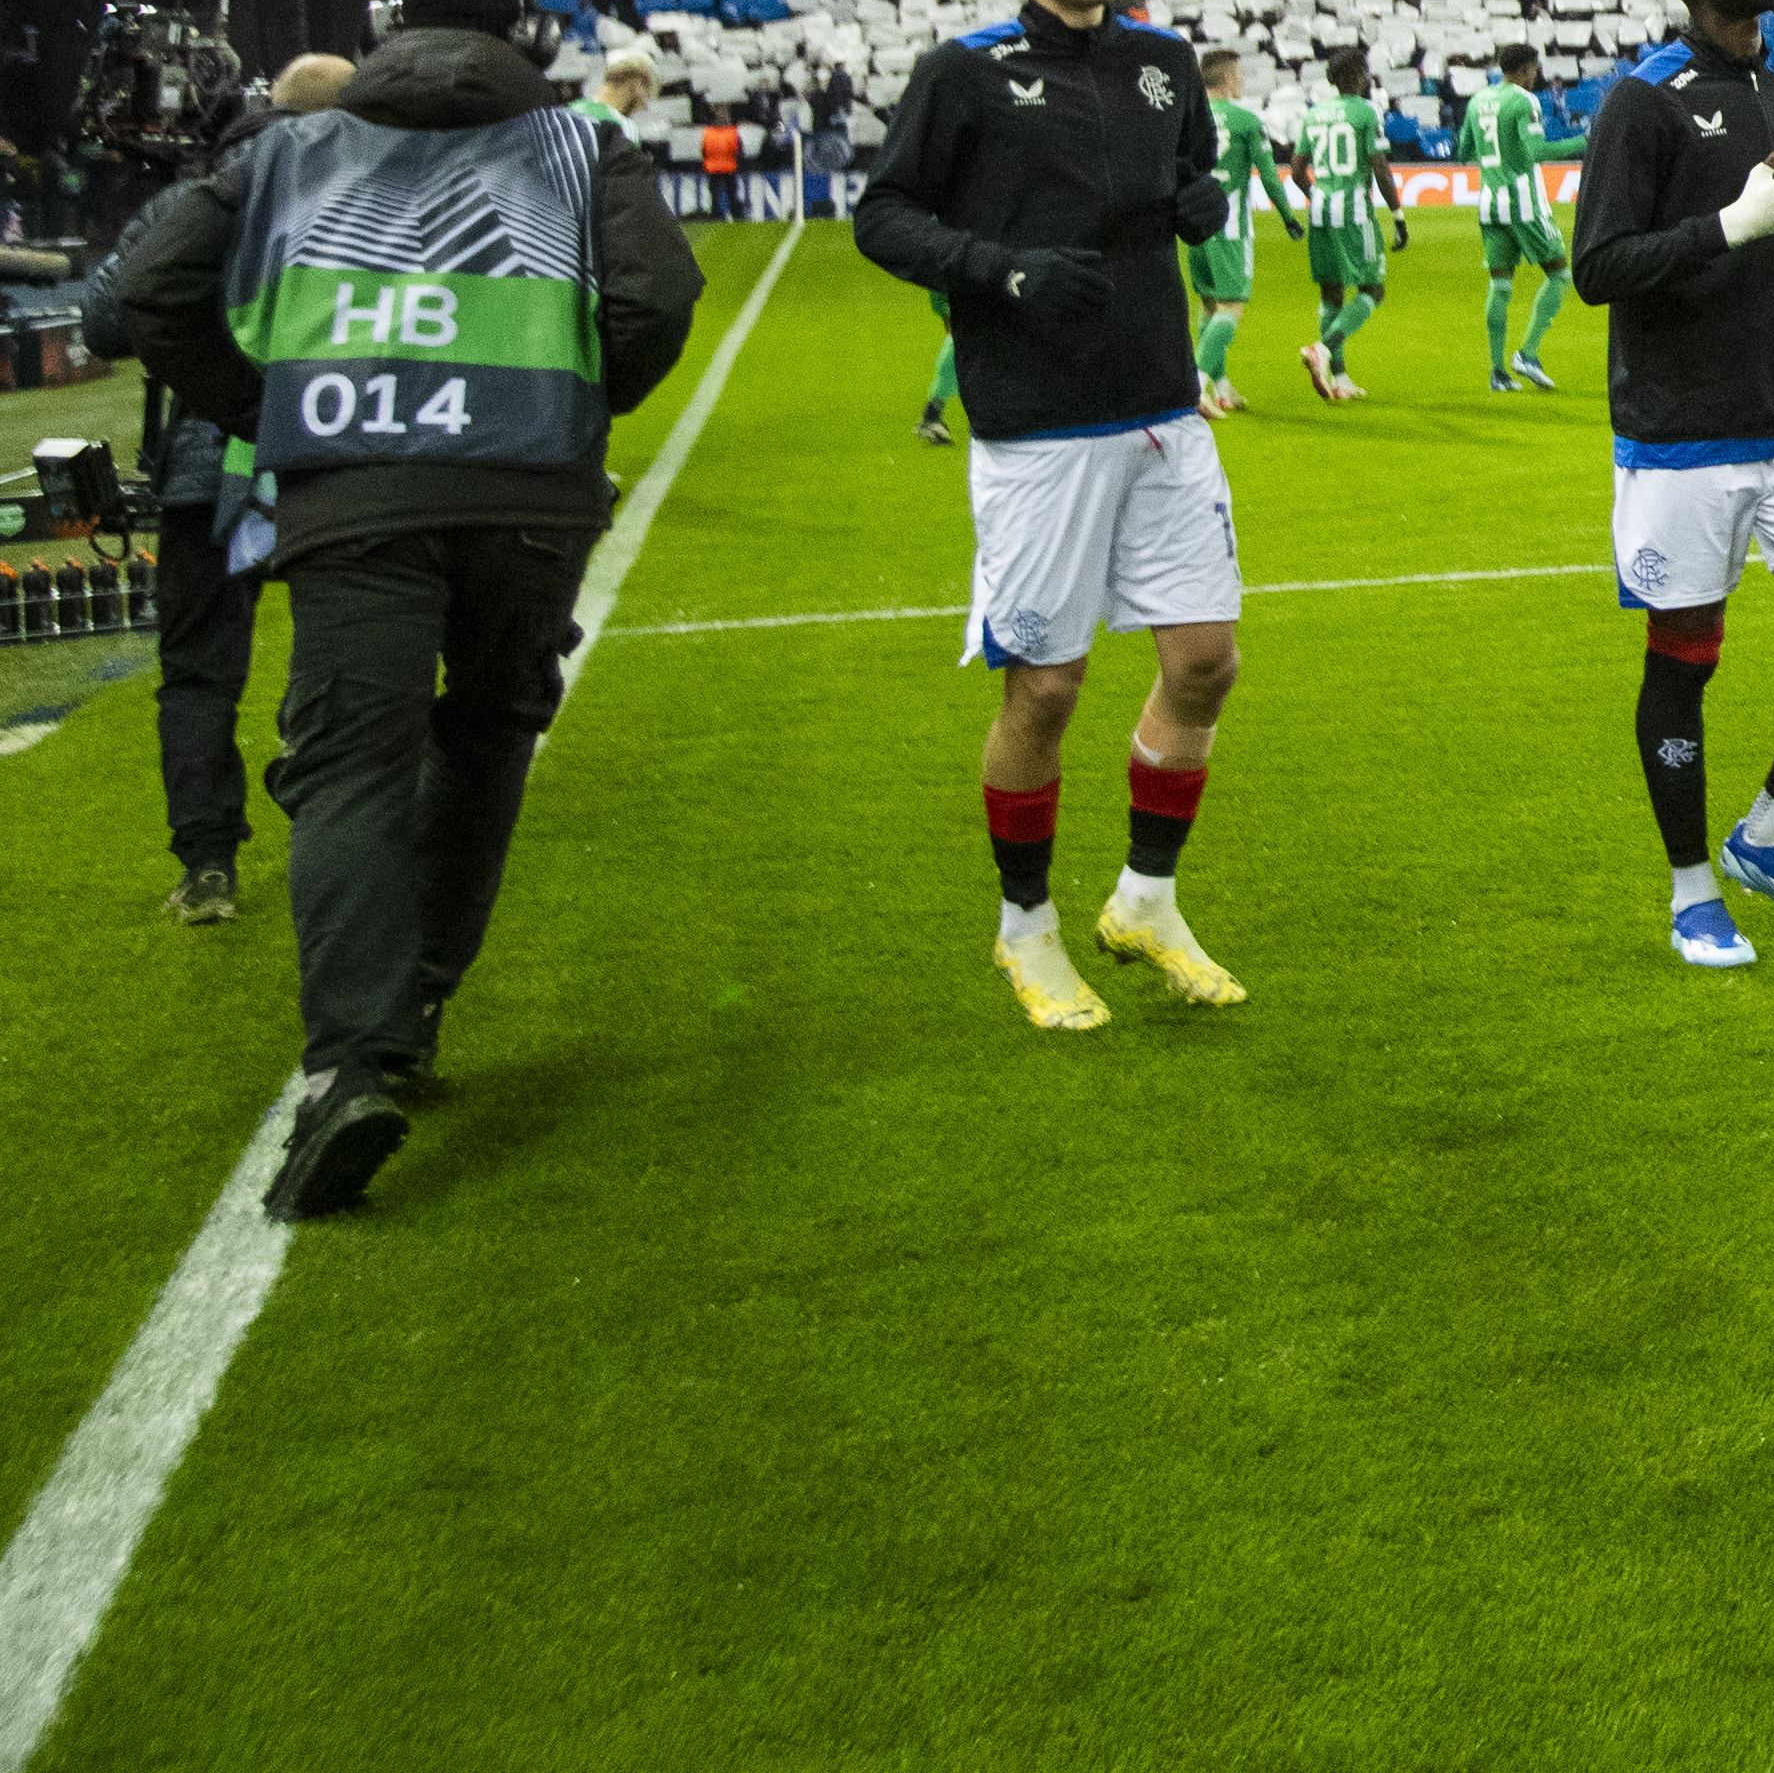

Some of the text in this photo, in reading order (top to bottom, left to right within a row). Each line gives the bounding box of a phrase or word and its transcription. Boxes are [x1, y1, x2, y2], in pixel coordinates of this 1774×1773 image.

[1307, 123, 1358, 177] 20
[331, 282, 458, 348] HB
[301, 373, 472, 437] 014
